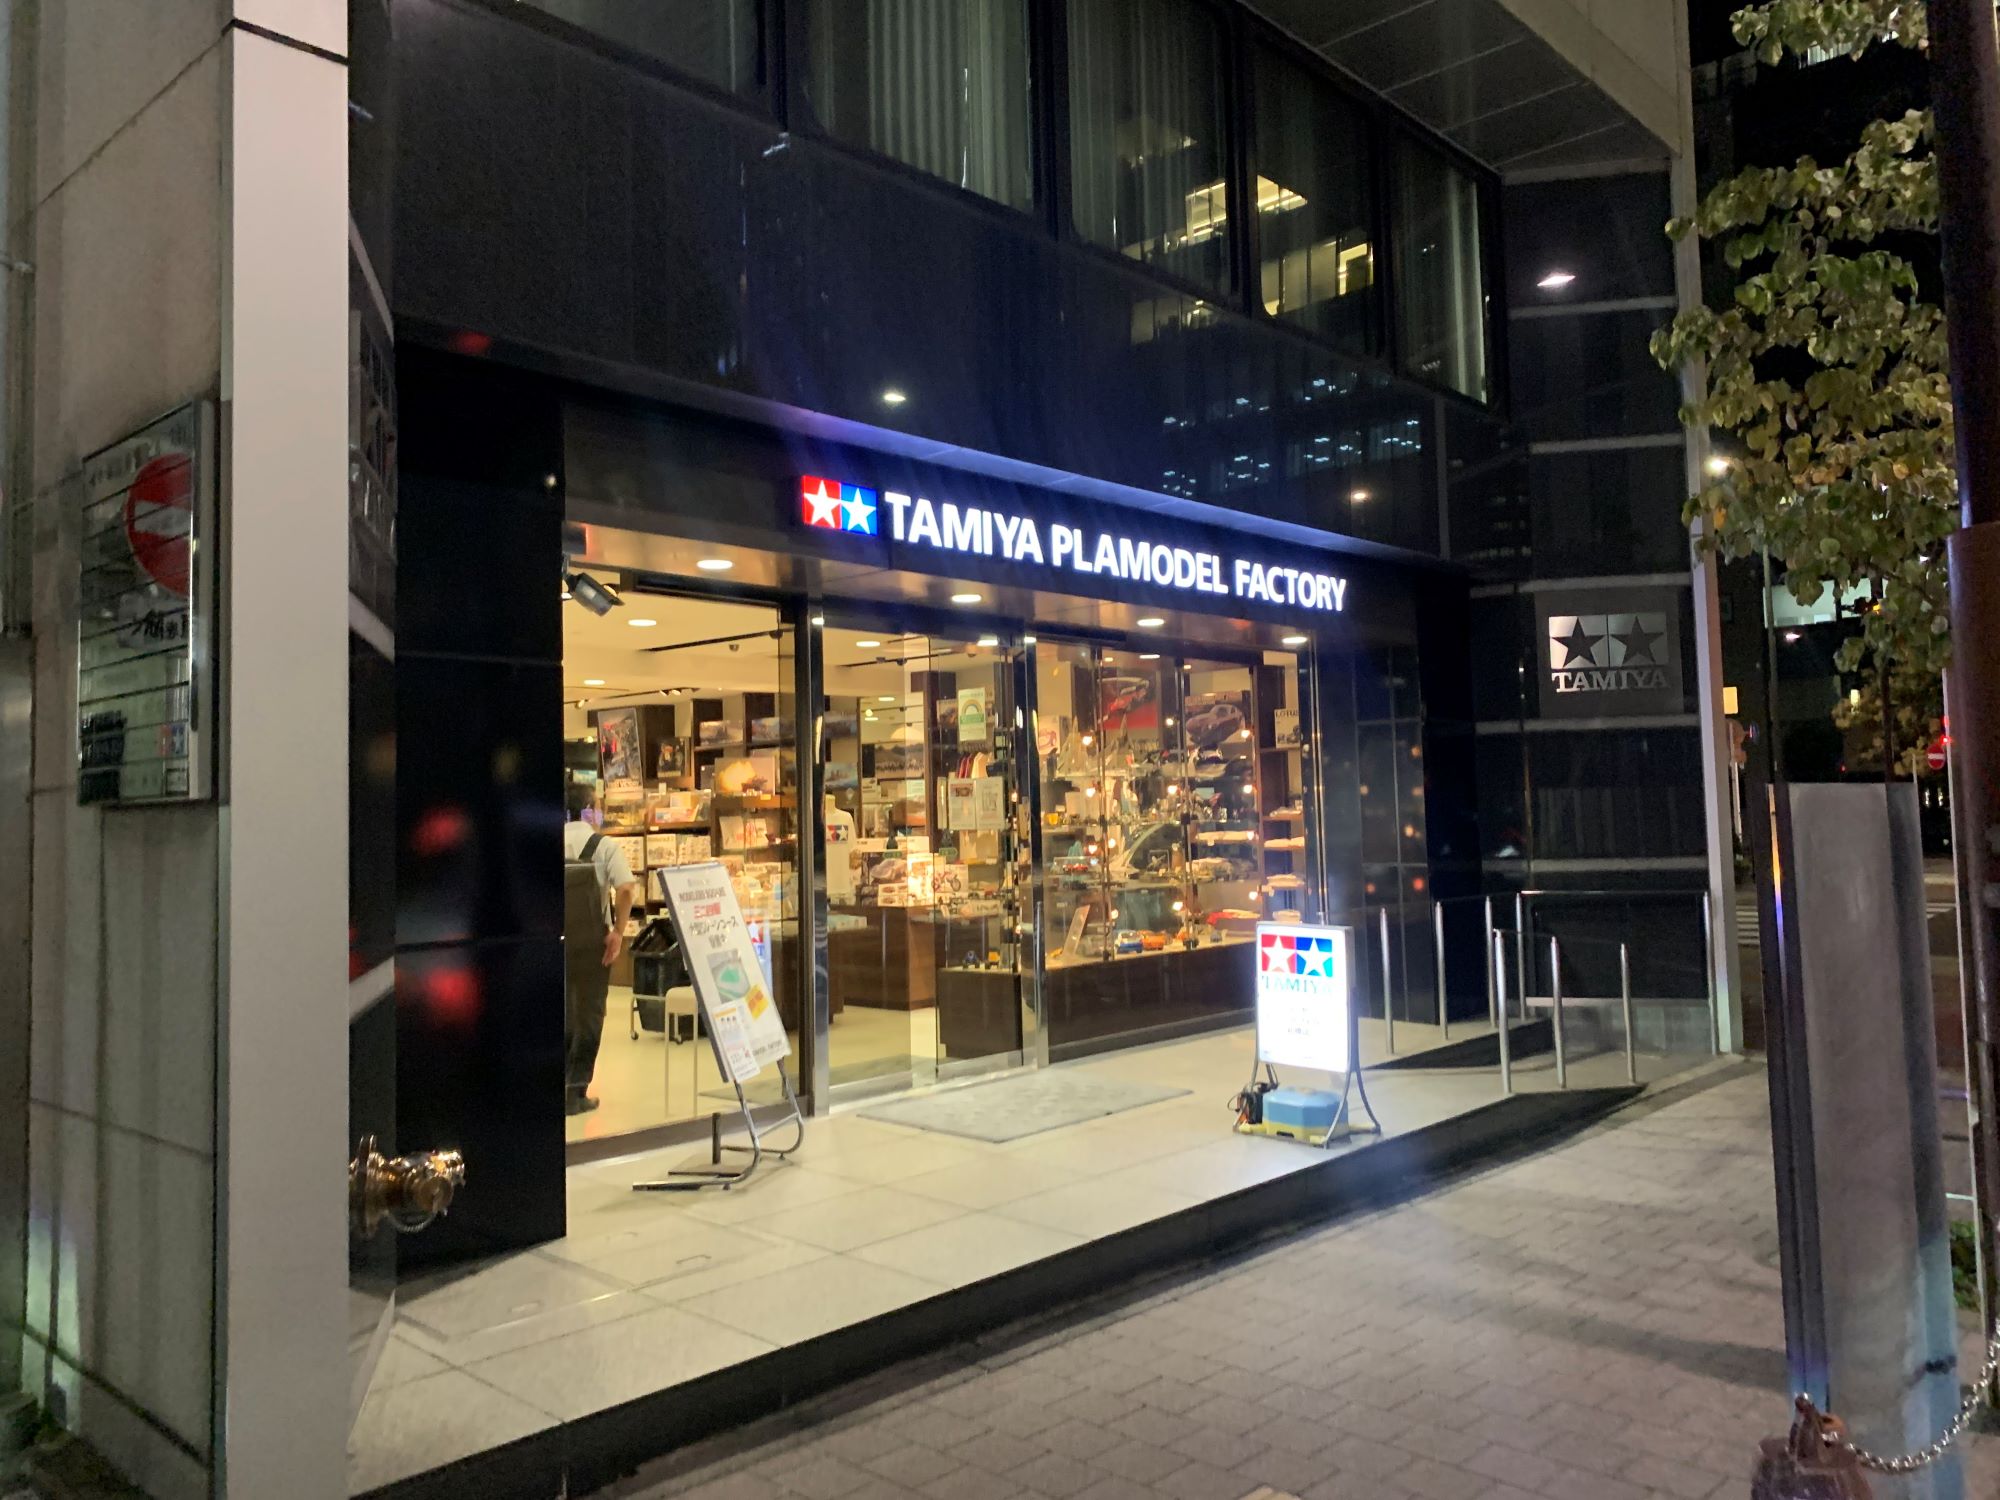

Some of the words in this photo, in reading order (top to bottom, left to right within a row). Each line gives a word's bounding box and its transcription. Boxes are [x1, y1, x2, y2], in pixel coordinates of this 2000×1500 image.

[884, 491, 1044, 564] TAMIYA
[1051, 523, 1229, 595] PLAMODEL
[1235, 559, 1348, 613] FACTORY
[1551, 669, 1670, 694] TAMIYA
